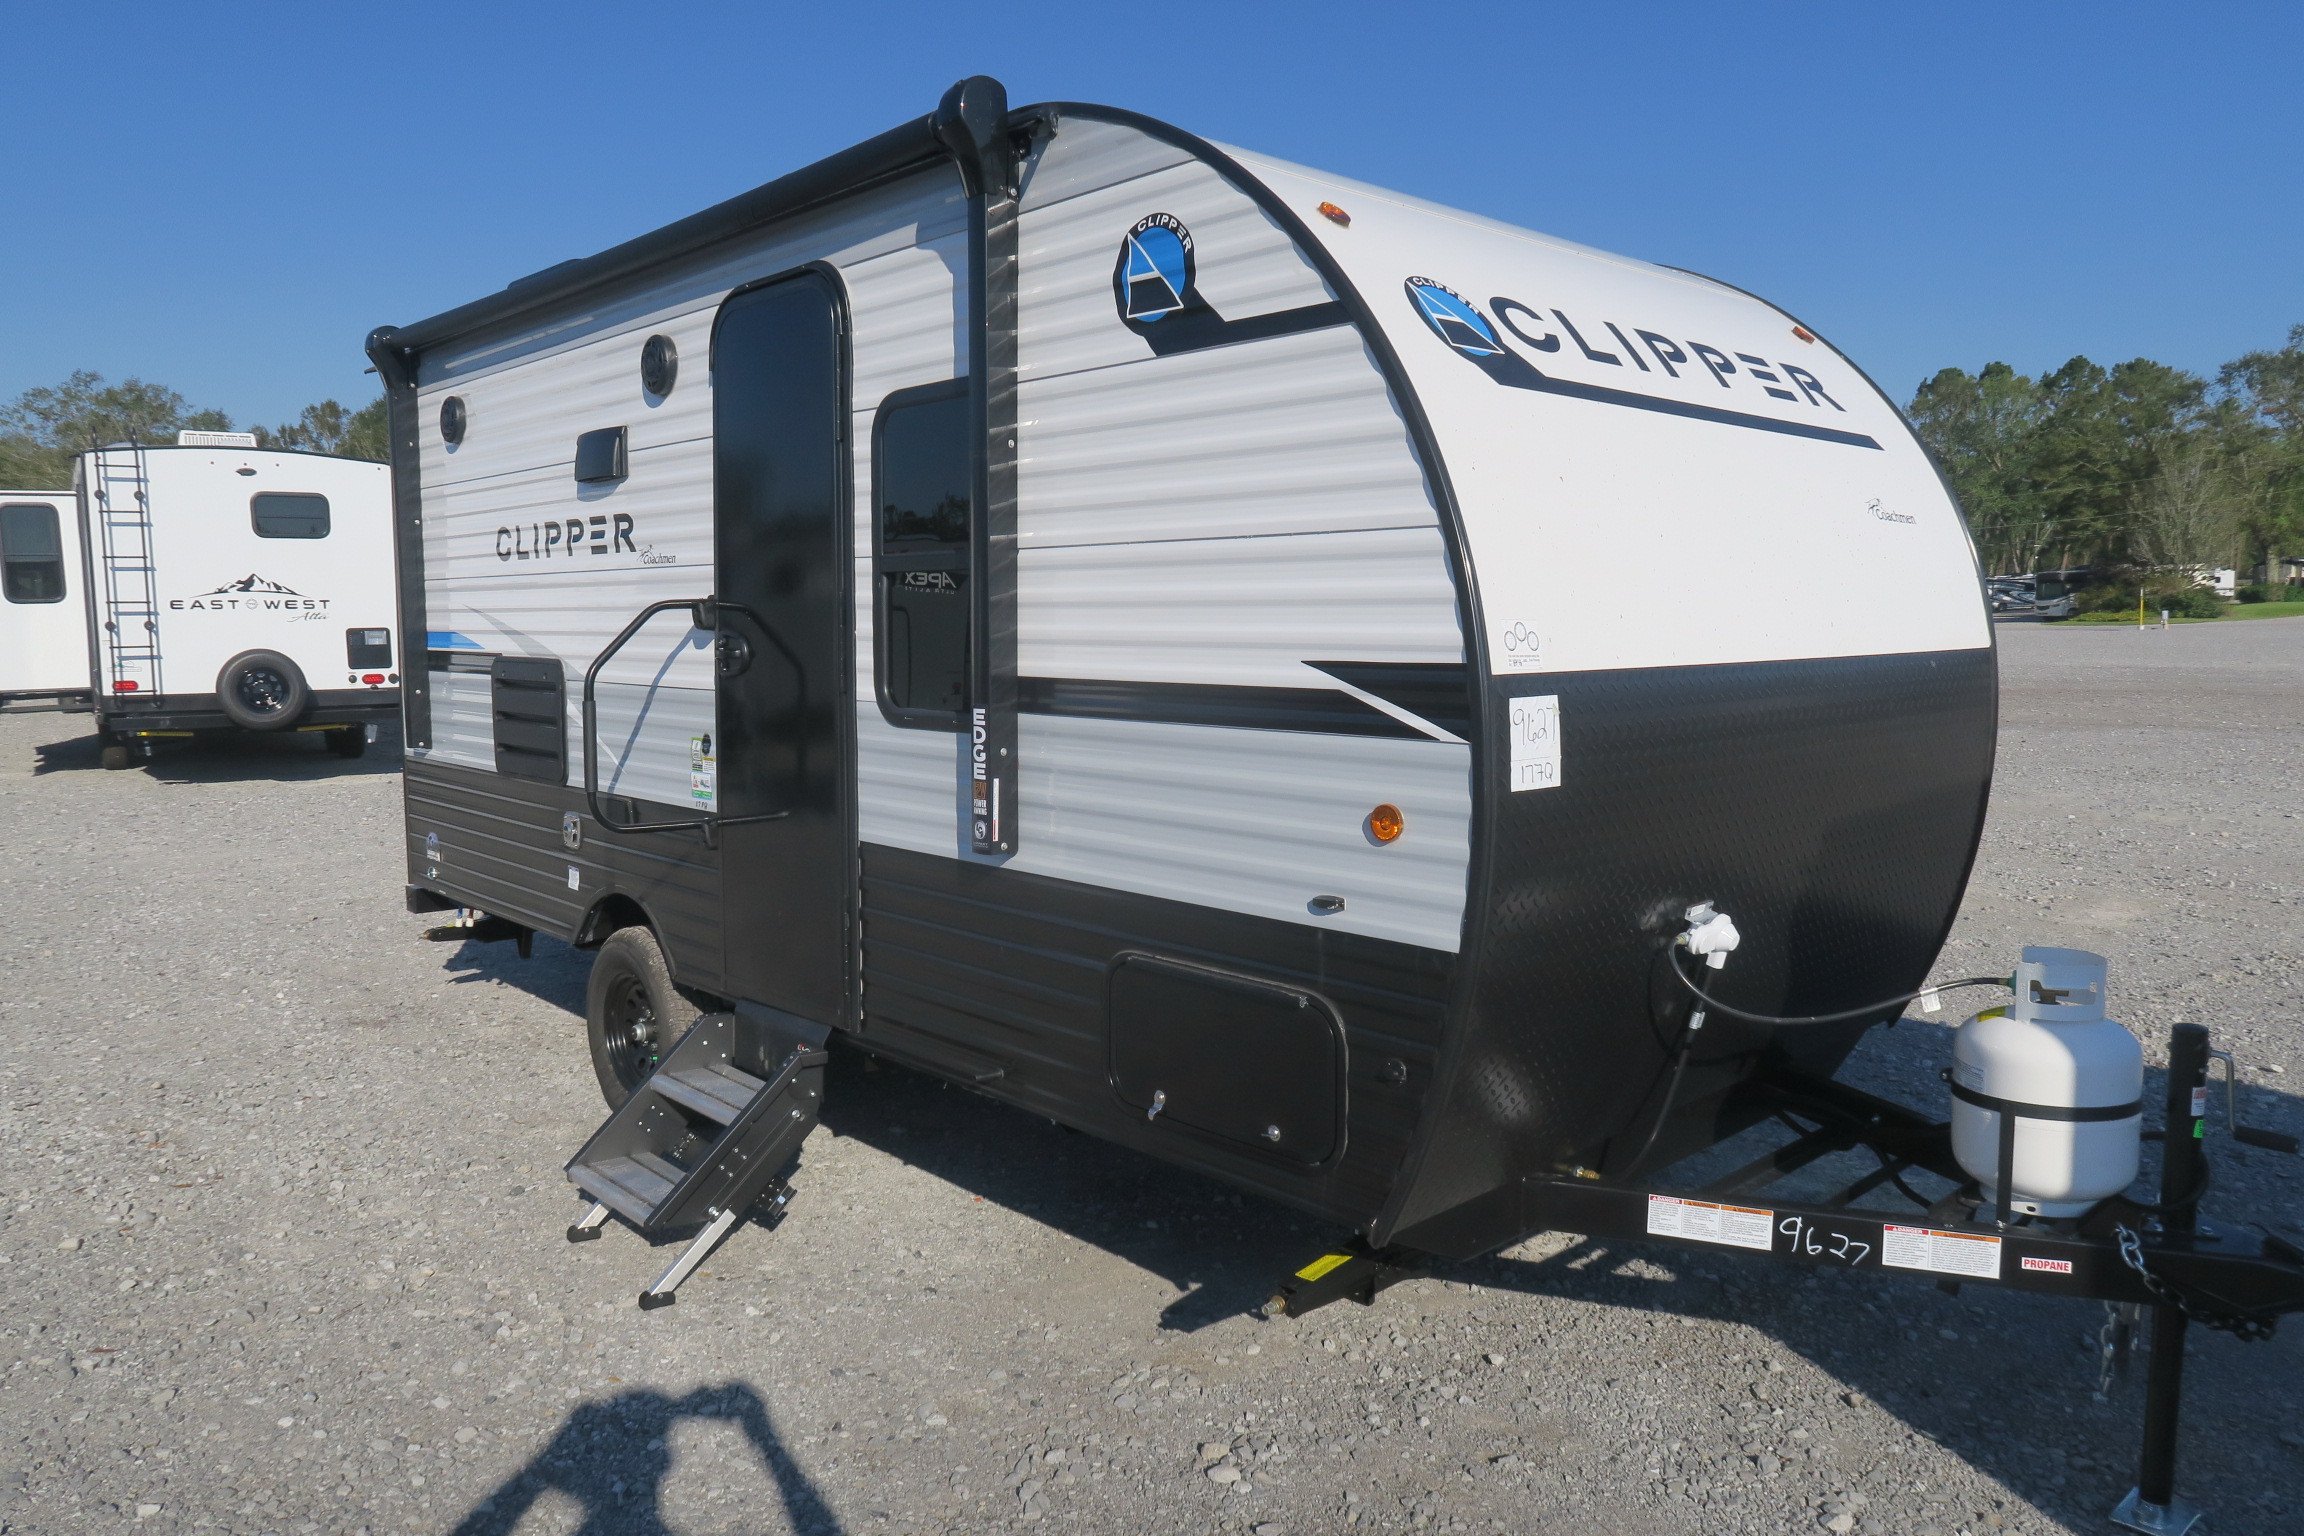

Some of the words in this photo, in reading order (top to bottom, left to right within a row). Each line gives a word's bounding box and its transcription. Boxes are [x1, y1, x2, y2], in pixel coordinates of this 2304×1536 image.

[1137, 214, 1192, 253] CLIPPER
[1489, 296, 1847, 412] CLIPPER
[1875, 508, 1917, 525] Coachmen
[496, 513, 637, 562] CLIPPER
[643, 554, 676, 565] Coachmen
[170, 600, 239, 610] EAST
[264, 600, 330, 610] WEST
[973, 708, 987, 780] EDGE
[1513, 708, 1557, 746] 9627
[1779, 1216, 1870, 1266] 9627
[2023, 1259, 2070, 1272] PROPANE
